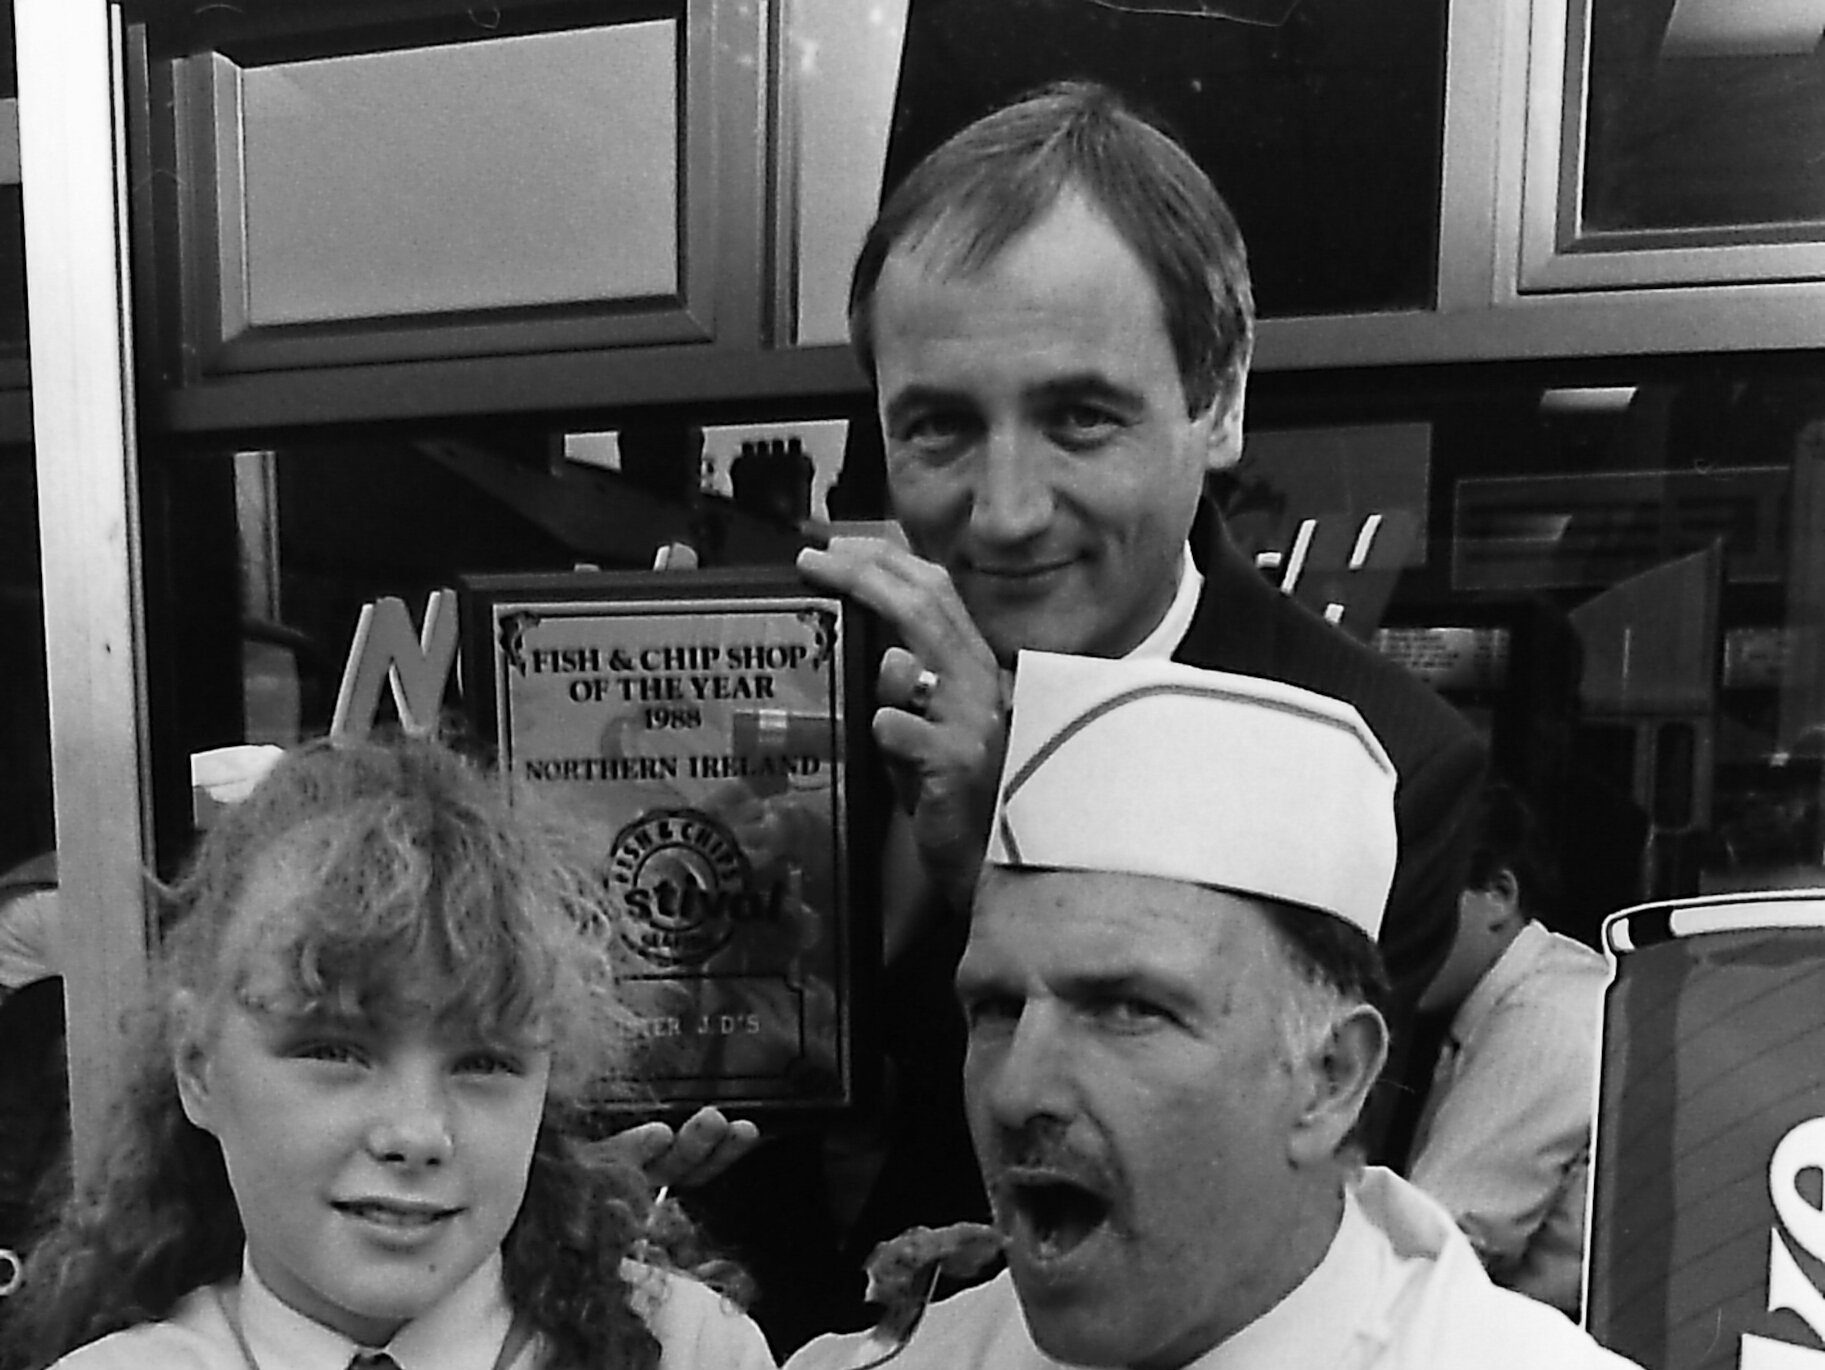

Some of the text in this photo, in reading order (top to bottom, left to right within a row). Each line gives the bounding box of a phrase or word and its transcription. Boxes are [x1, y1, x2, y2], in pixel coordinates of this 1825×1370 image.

[532, 645, 807, 673] FISH & CHIP SHOP
[569, 676, 774, 702] OF THE YEAR
[645, 707, 702, 730] 1988
[525, 756, 821, 781] NORTHERN IRELAND
